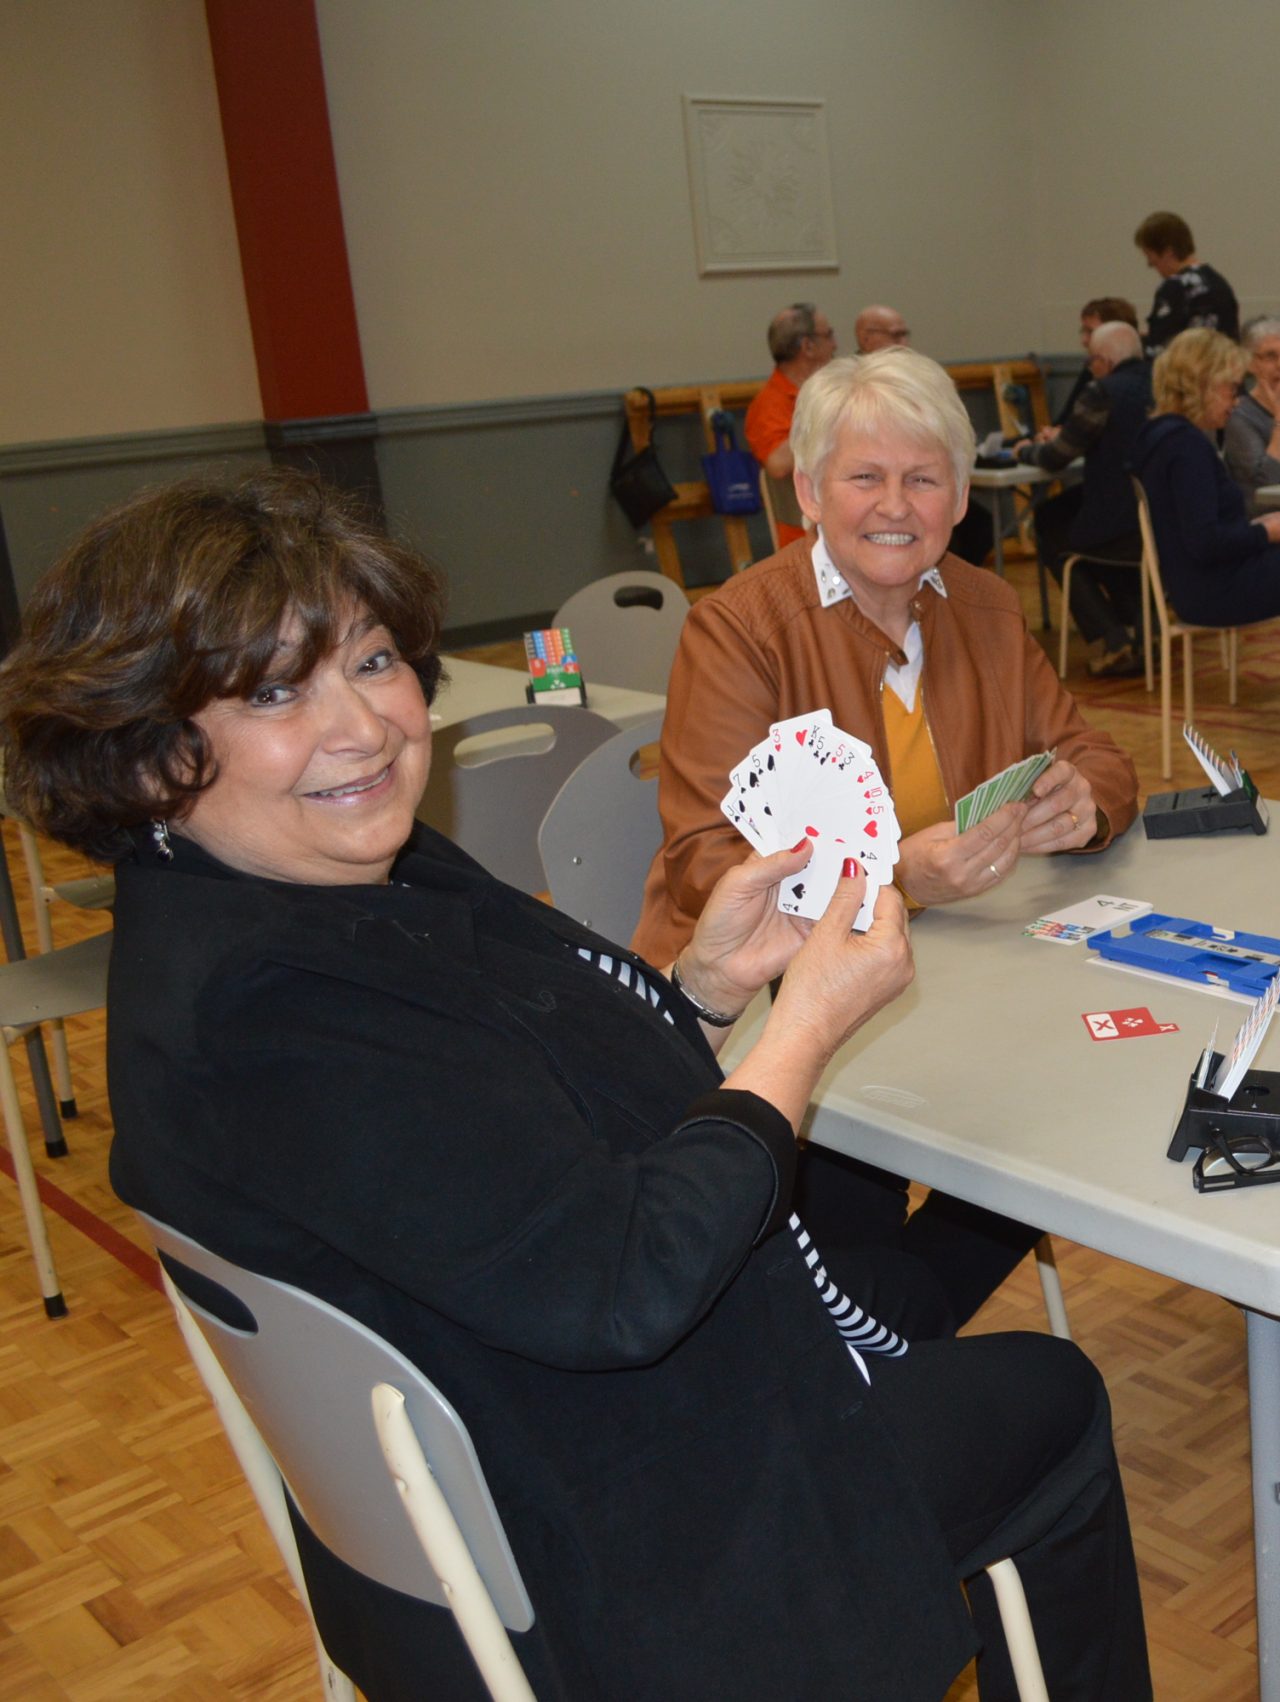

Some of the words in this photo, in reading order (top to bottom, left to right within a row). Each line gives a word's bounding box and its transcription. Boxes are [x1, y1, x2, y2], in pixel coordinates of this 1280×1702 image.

[772, 728, 781, 743] 3
[811, 725, 820, 739] K
[816, 735, 825, 750] 5
[835, 743, 846, 758] 5
[751, 754, 761, 768] 5
[843, 751, 856, 766] 3
[732, 772, 741, 787] 7
[870, 787, 883, 798] 10
[726, 804, 735, 817] J
[872, 805, 884, 815] 5
[866, 851, 878, 861] 4
[781, 902, 793, 912] 4
[1092, 1019, 1116, 1032] X
[1158, 1024, 1176, 1032] X
